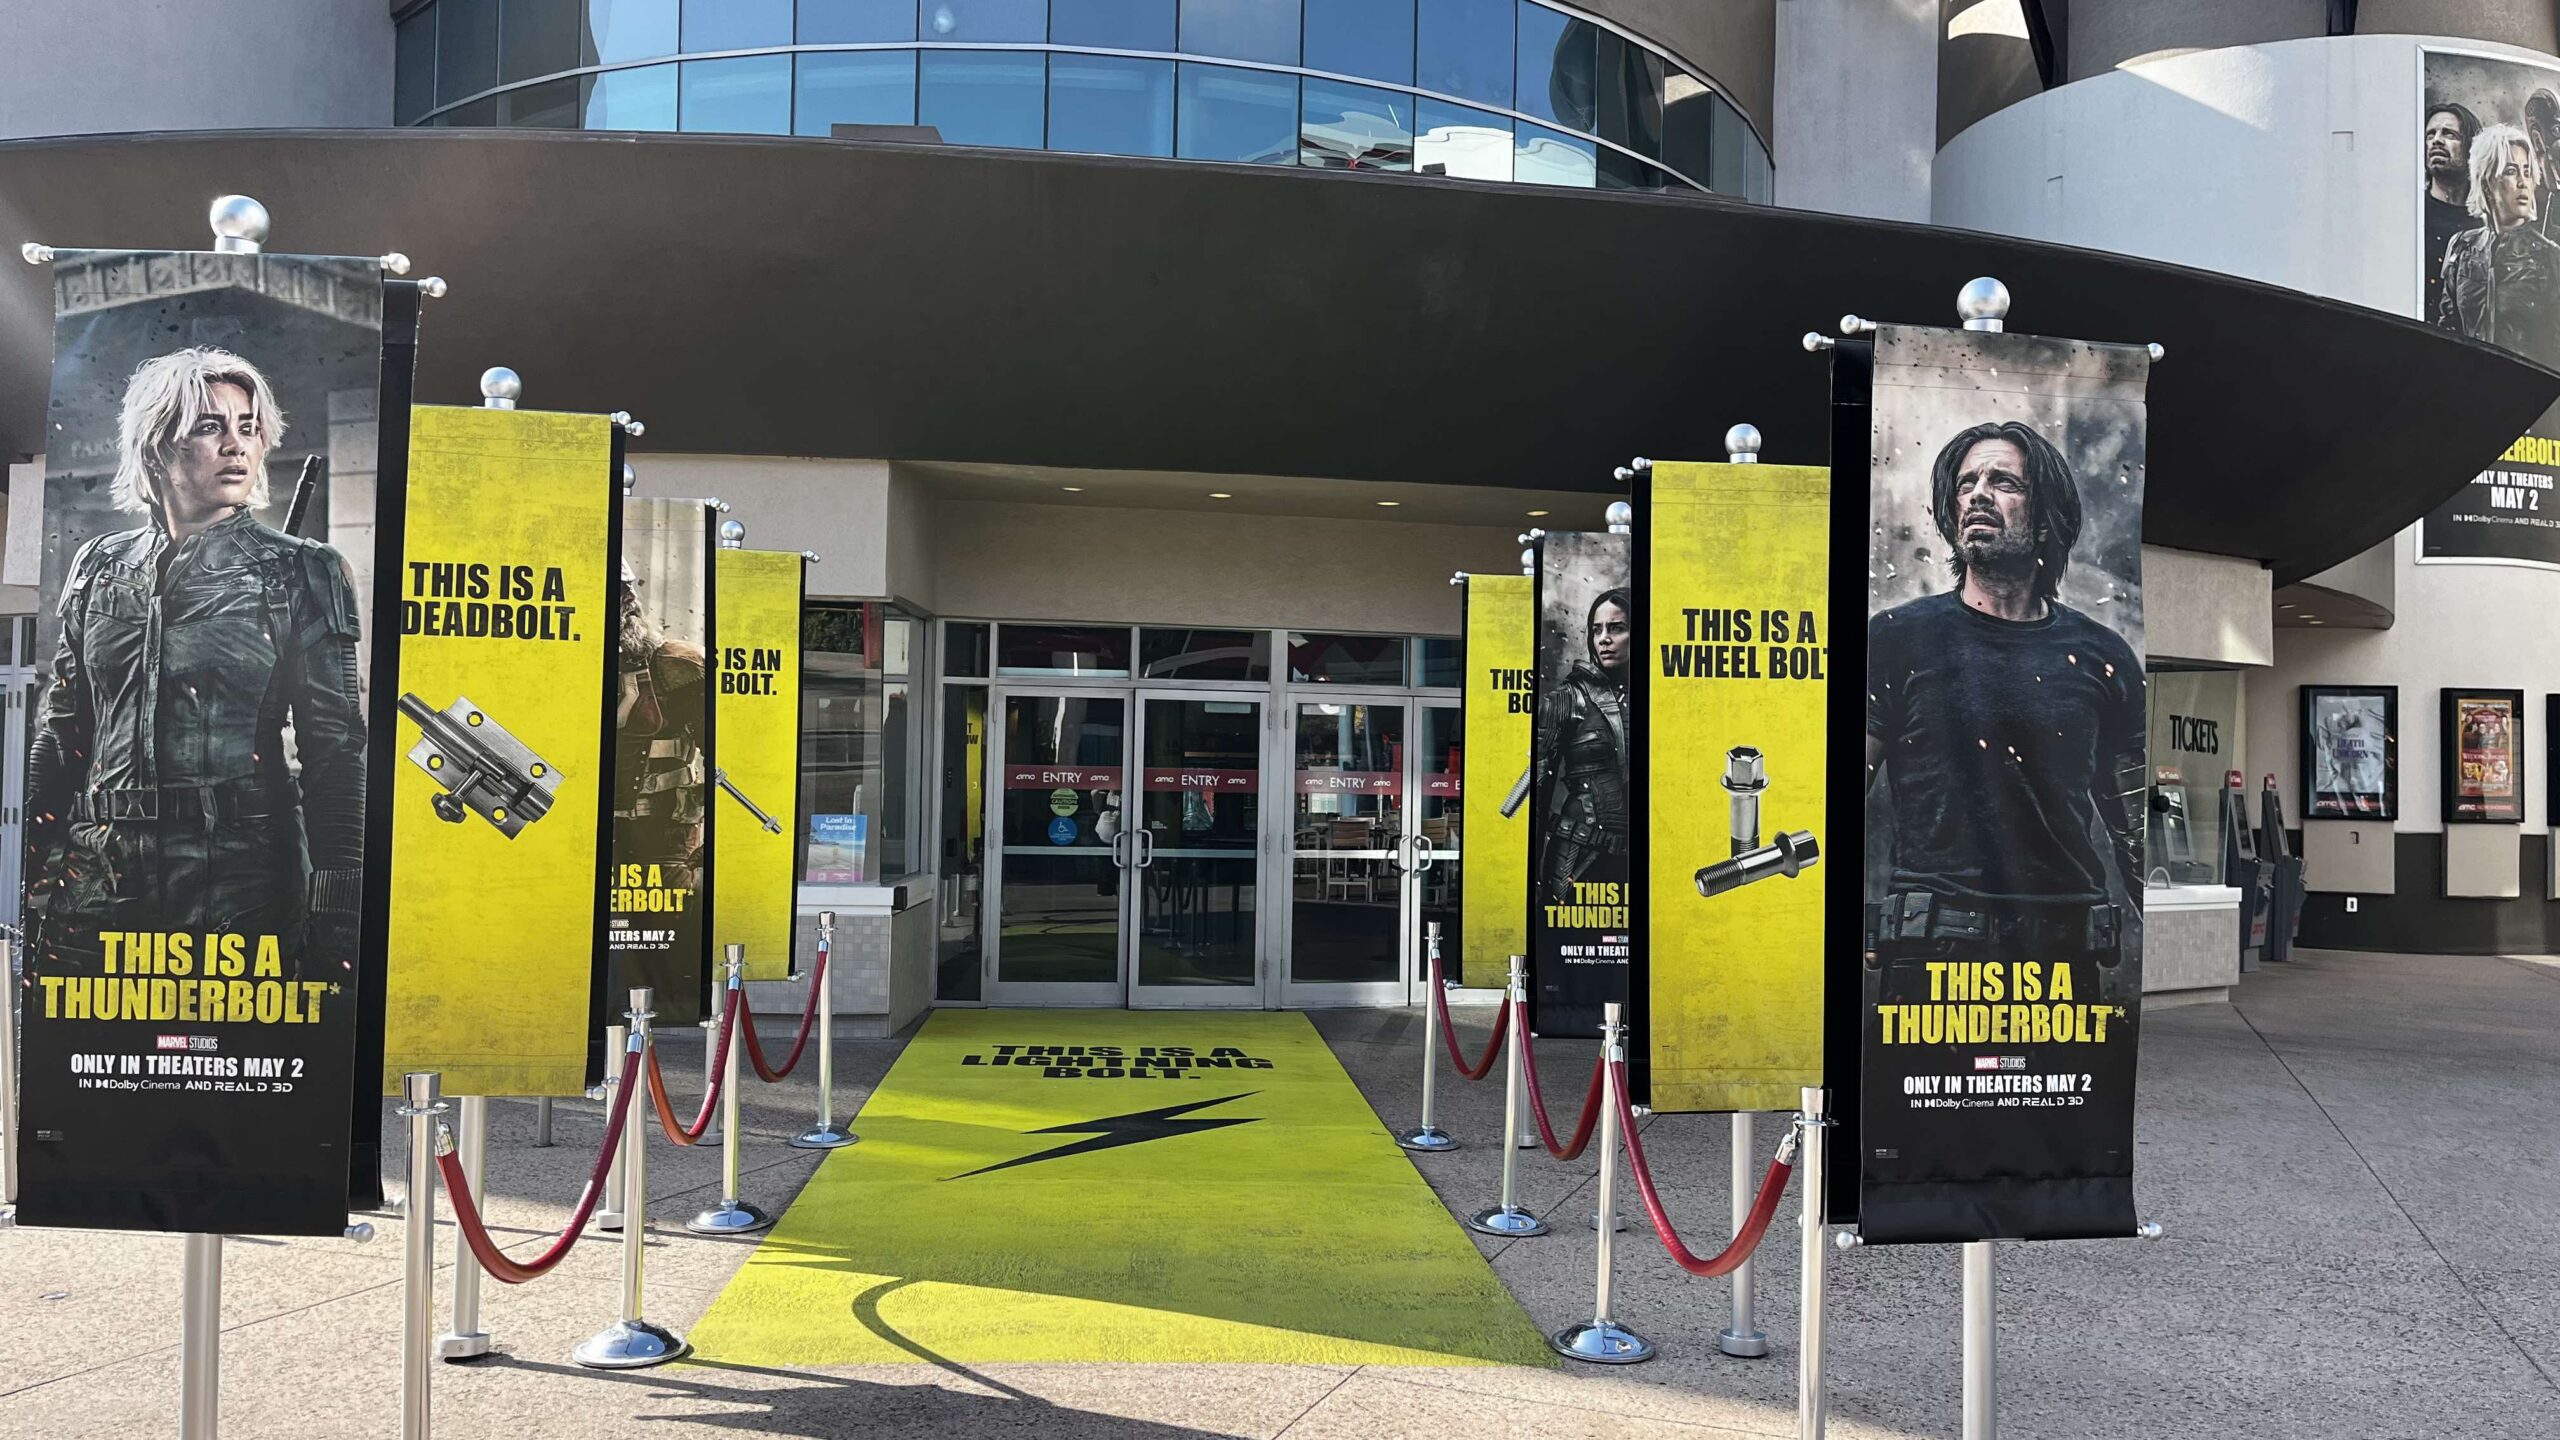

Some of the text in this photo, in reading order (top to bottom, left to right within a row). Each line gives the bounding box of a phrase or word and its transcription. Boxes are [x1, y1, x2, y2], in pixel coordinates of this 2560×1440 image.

[2497, 471, 2508, 485] IN
[2510, 471, 2553, 489] THEATERS
[2491, 486, 2538, 511] MAY 2
[2453, 514, 2462, 522] IN
[2472, 515, 2491, 524] Dolby
[2491, 516, 2513, 524] Cinema
[2514, 517, 2529, 525] AND
[409, 562, 566, 602] THIS IS A
[401, 600, 581, 641] DEADBOLT.
[1682, 608, 1817, 644] THIS IS A
[725, 648, 746, 671] IS
[751, 649, 781, 671] AN
[1661, 645, 1828, 680] WHEEL BOL
[721, 672, 777, 695] BOLT.
[1490, 669, 1533, 691] THIS
[1508, 693, 1533, 714] BO
[2169, 714, 2218, 755] TICKETS
[1043, 772, 1082, 784] ENTRY
[1182, 775, 1220, 787] ENTRY
[1330, 777, 1366, 788] ENTRY
[620, 863, 643, 888] IS
[646, 864, 663, 888] A
[610, 888, 696, 913] ERBOLT
[1573, 882, 1620, 905] THIS
[1544, 905, 1629, 928] THUNDE
[608, 930, 676, 942] ATERS MAY 2
[99, 931, 281, 977] THIS IS A
[1561, 945, 1629, 957] ONLY IN THEAT
[1925, 961, 2073, 1001] THIS IS A
[157, 1035, 218, 1051] MARVEL STUDIOS
[992, 1045, 1248, 1058] THIS IS A
[70, 1054, 304, 1078] ONLY IN THEATERS MAY 2
[961, 1055, 1275, 1069] LIGHTNING
[1042, 1066, 1201, 1079] BOLT.
[1974, 1056, 2026, 1070] MARVEL STUDIOS
[79, 1078, 92, 1088] IN
[109, 1079, 139, 1091] Dolby
[140, 1079, 181, 1090] Cinema
[184, 1081, 212, 1091] AND
[271, 1083, 293, 1093] 3D
[1903, 1074, 2092, 1095] ONLY IN THEATERS MAY 2
[1910, 1099, 1922, 1108] IN
[1936, 1099, 1961, 1109] Dolby
[1961, 1098, 1994, 1108] Cinema
[1997, 1097, 2020, 1107] AND
[2067, 1096, 2084, 1106] 3D
